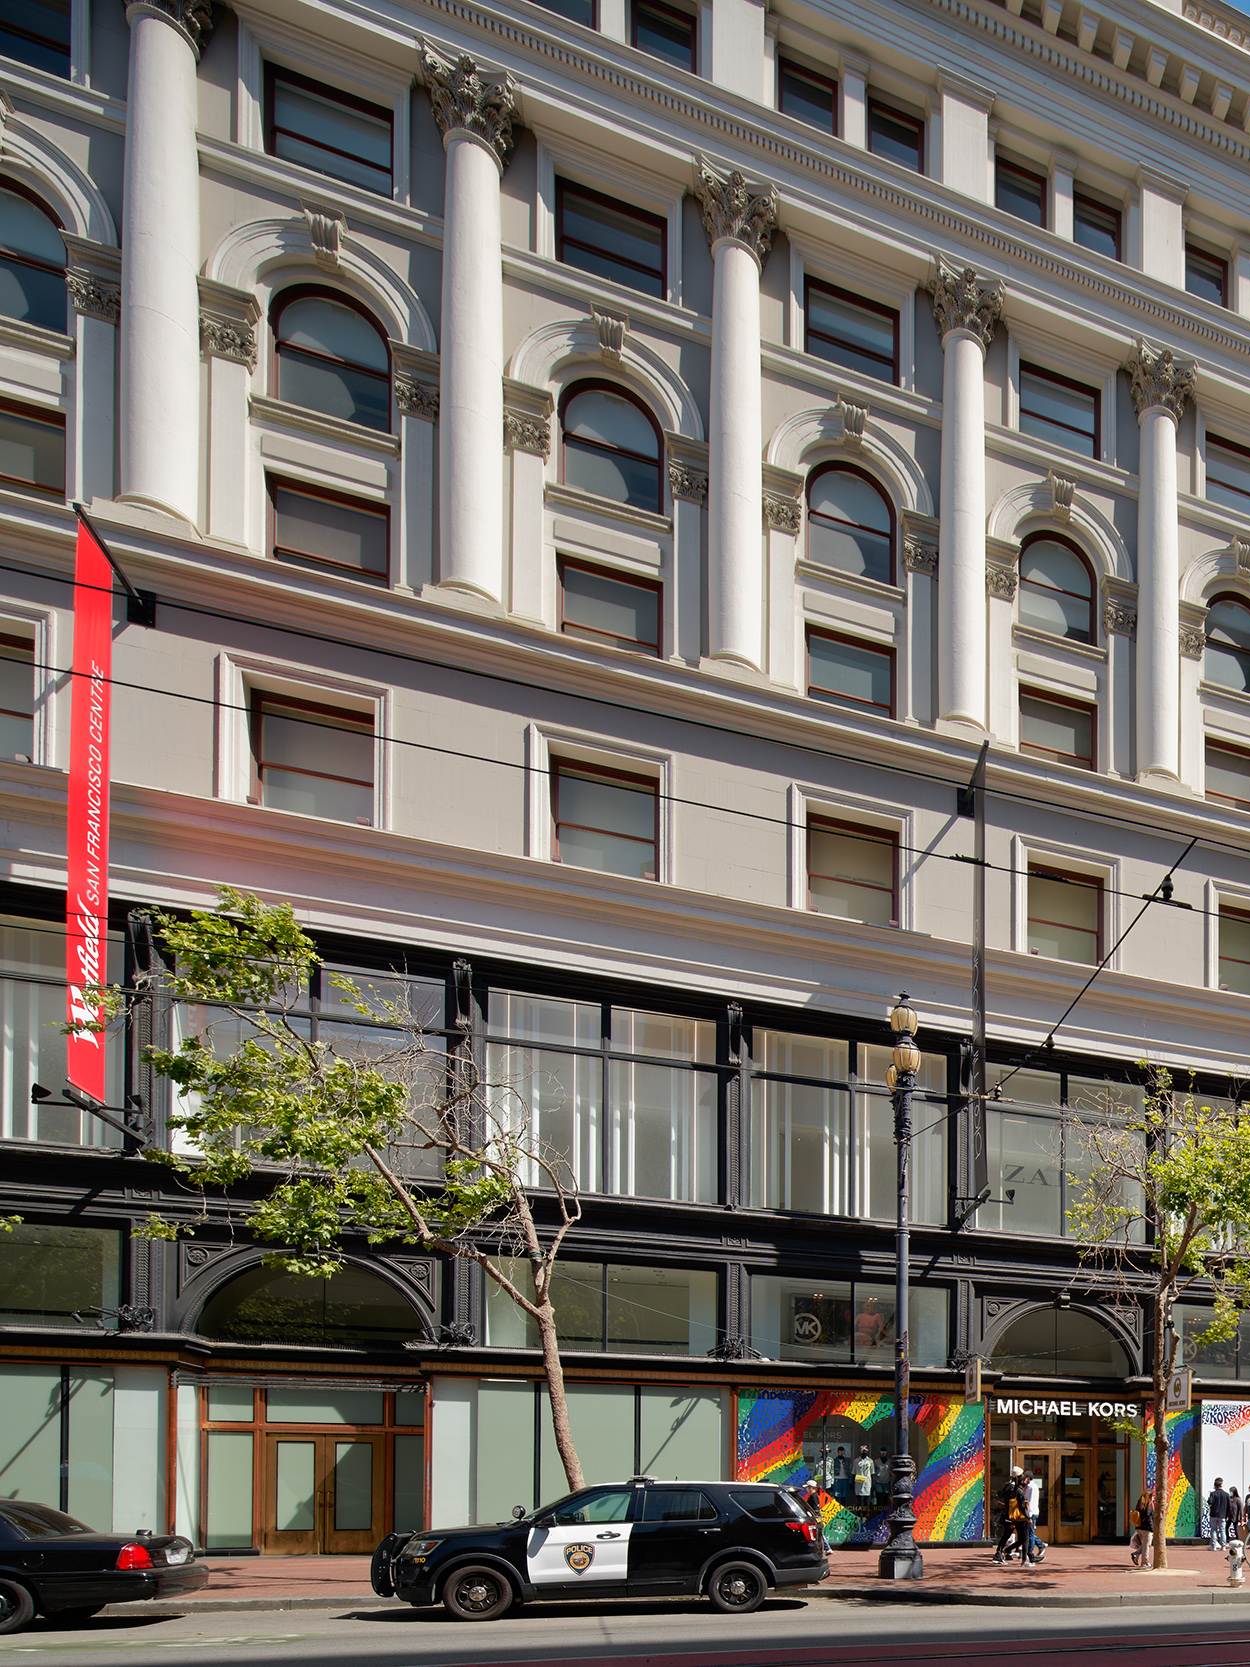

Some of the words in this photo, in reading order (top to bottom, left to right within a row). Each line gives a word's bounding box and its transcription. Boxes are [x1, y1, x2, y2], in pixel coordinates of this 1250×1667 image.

[90, 660, 104, 743] CENTRE
[88, 744, 102, 861] FRANCISCO
[87, 860, 100, 906] SAN
[71, 894, 99, 1049] Wtfield
[996, 1399, 1082, 1416] MICHAEL
[1088, 1402, 1138, 1417] KORS
[566, 1544, 593, 1555] POLICE
